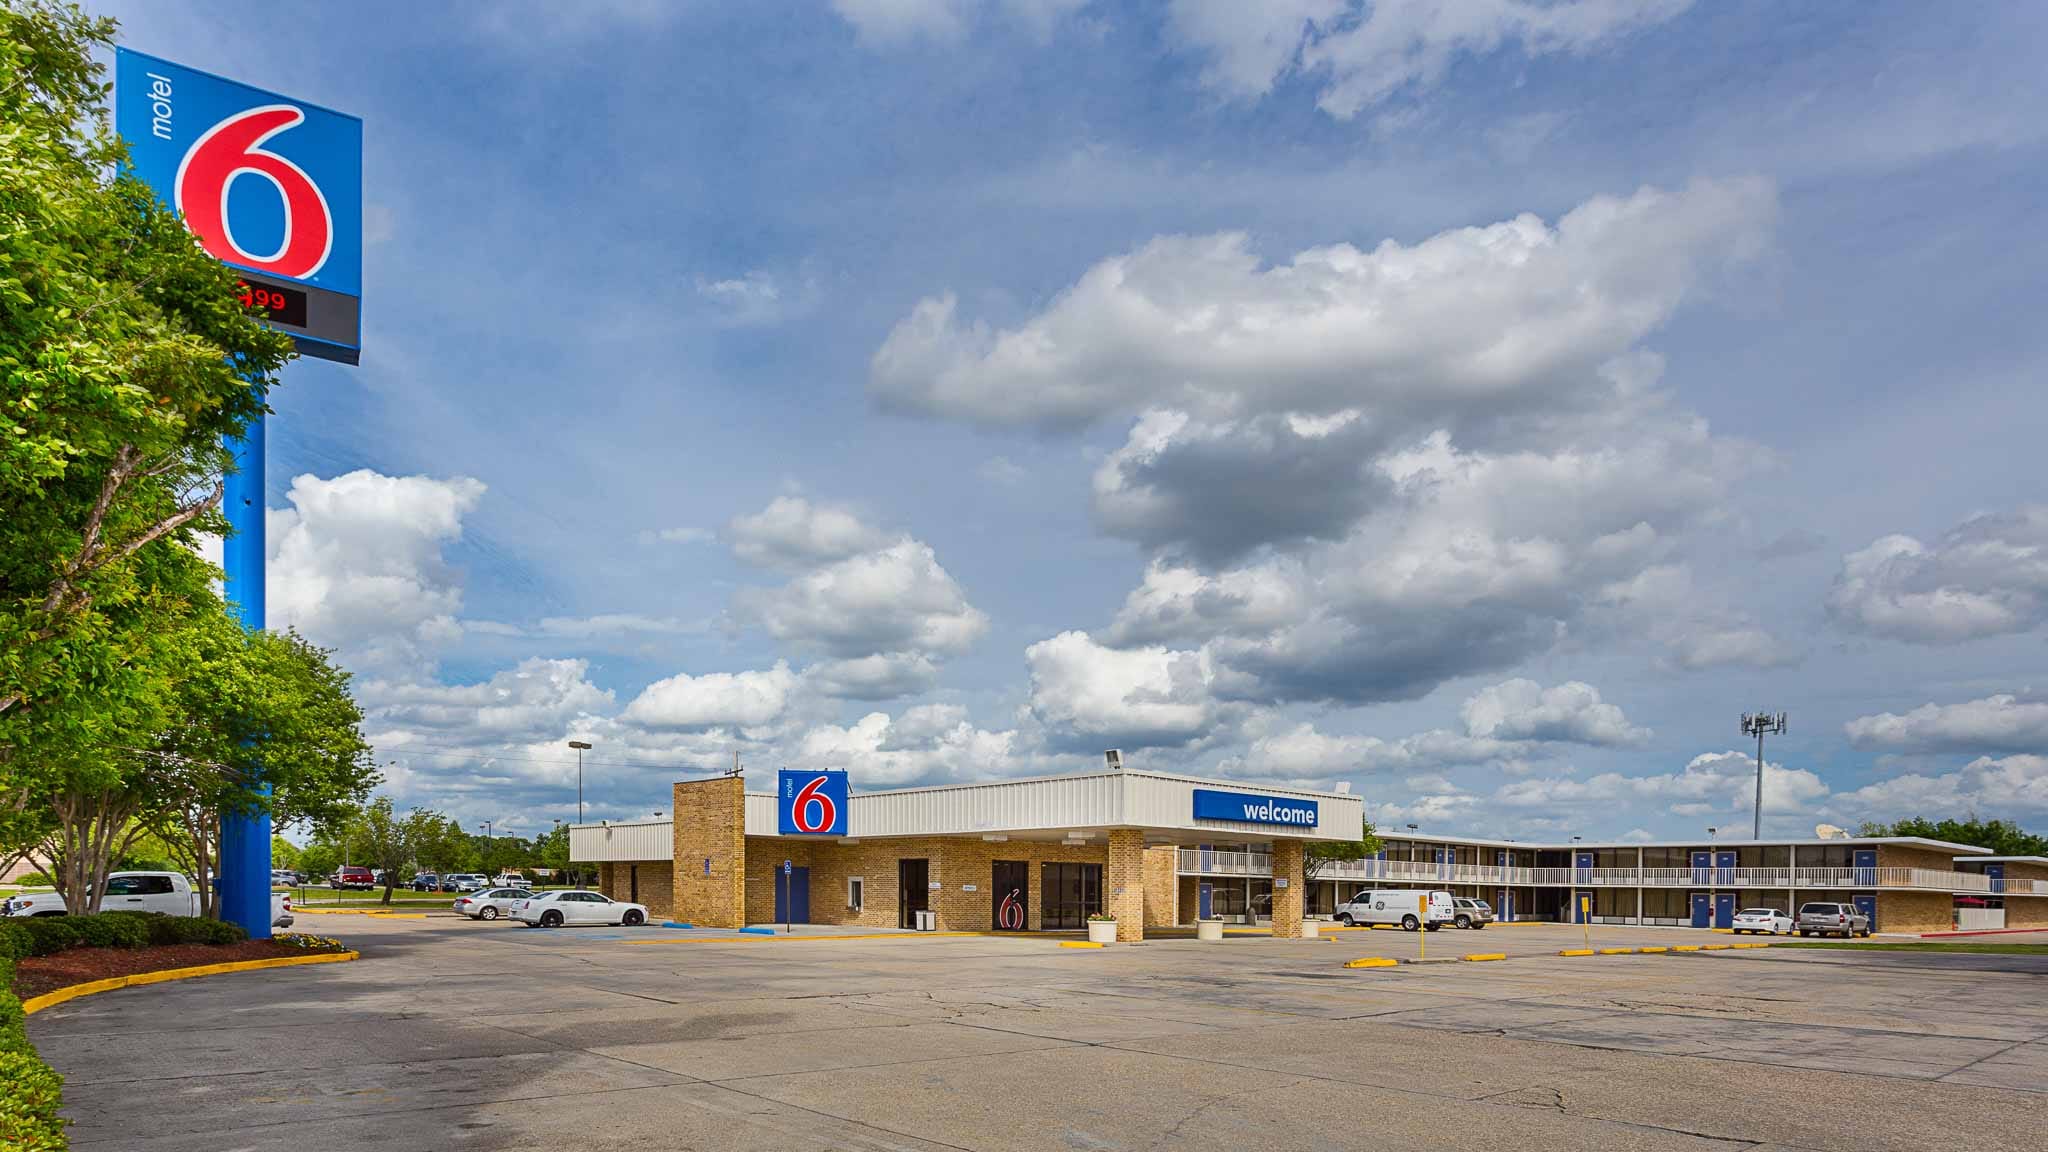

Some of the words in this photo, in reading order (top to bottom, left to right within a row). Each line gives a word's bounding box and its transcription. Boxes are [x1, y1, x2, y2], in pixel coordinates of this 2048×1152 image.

[147, 72, 171, 140] motel
[174, 104, 333, 280] 6
[792, 775, 836, 833] 6
[1243, 799, 1315, 824] welcome
[1000, 888, 1024, 928] 6
